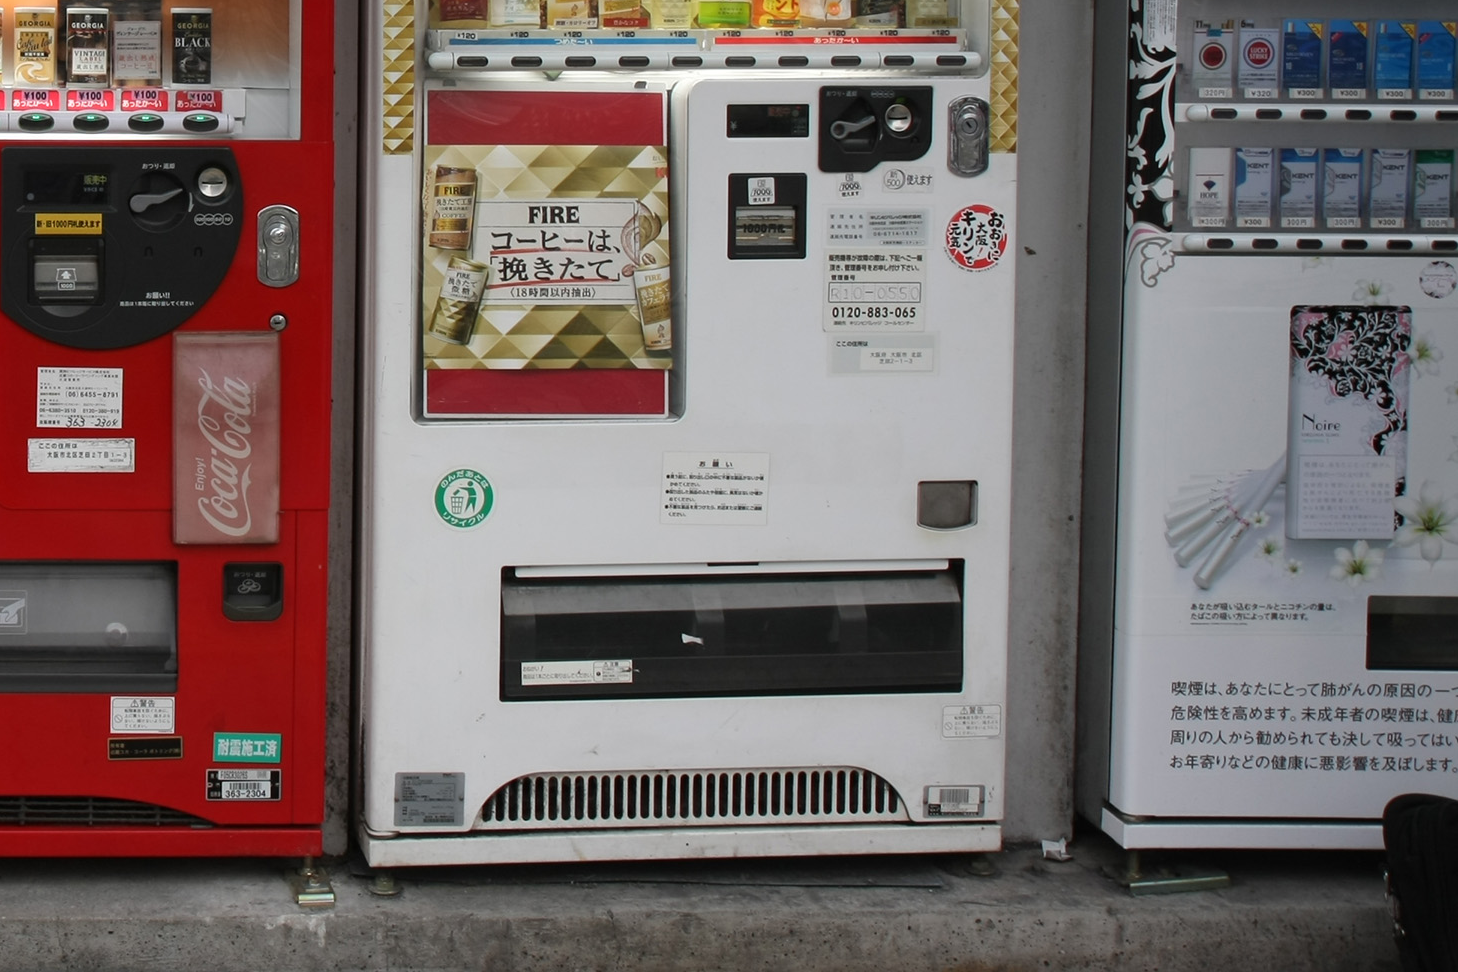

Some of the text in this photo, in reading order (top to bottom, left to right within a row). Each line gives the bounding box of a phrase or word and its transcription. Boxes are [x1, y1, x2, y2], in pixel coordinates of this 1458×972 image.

[528, 205, 580, 224] FIRE
[490, 229, 622, 254] コーヒーは、
[832, 306, 917, 318] 0120-883-065
[197, 366, 252, 537] Coca-Cola
[194, 457, 205, 491] Enjoy!
